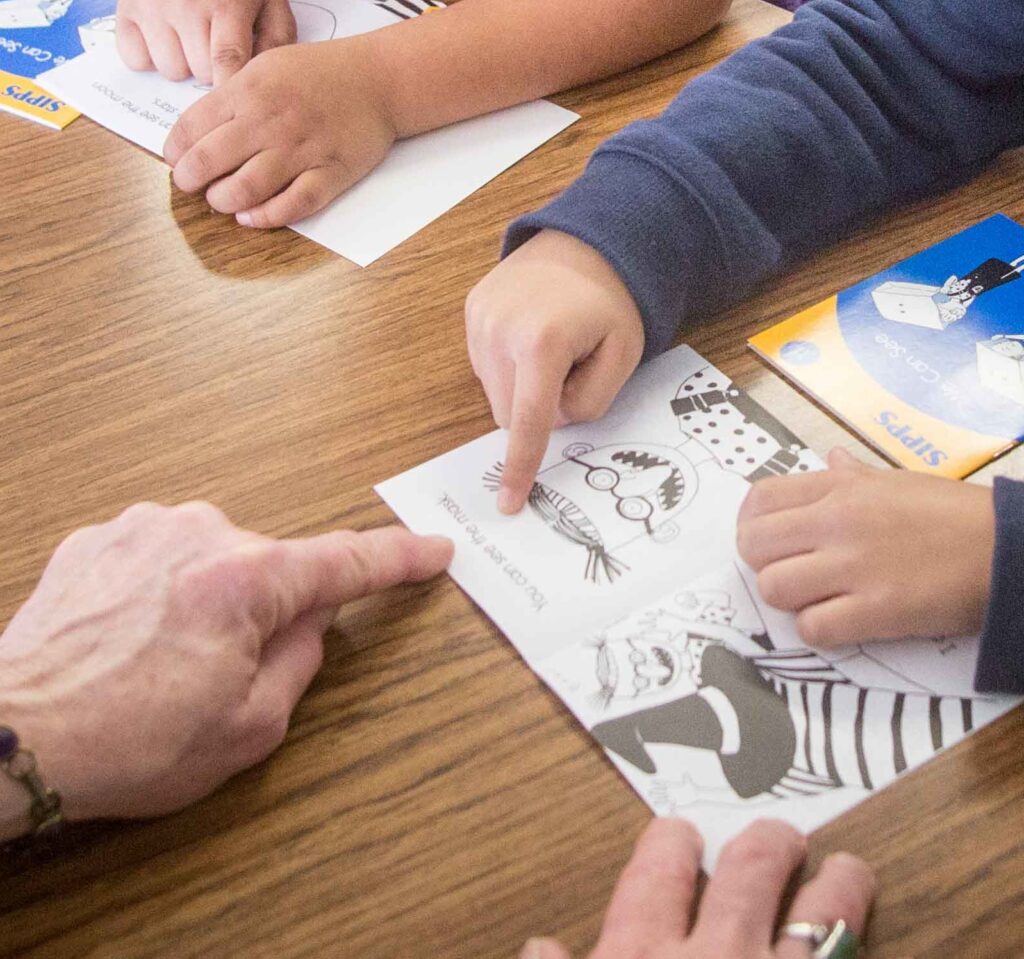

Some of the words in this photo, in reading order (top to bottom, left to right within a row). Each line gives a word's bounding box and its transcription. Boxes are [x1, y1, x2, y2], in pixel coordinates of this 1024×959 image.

[22, 45, 53, 62] Can
[1, 85, 66, 113] SIPPS
[91, 81, 123, 102] moon
[121, 100, 141, 114] the
[874, 333, 906, 358] See
[906, 355, 940, 383] Can
[873, 411, 948, 466] SIPPS
[465, 523, 487, 545] the
[483, 544, 507, 565] see
[503, 563, 528, 586] can
[525, 585, 549, 613] You
